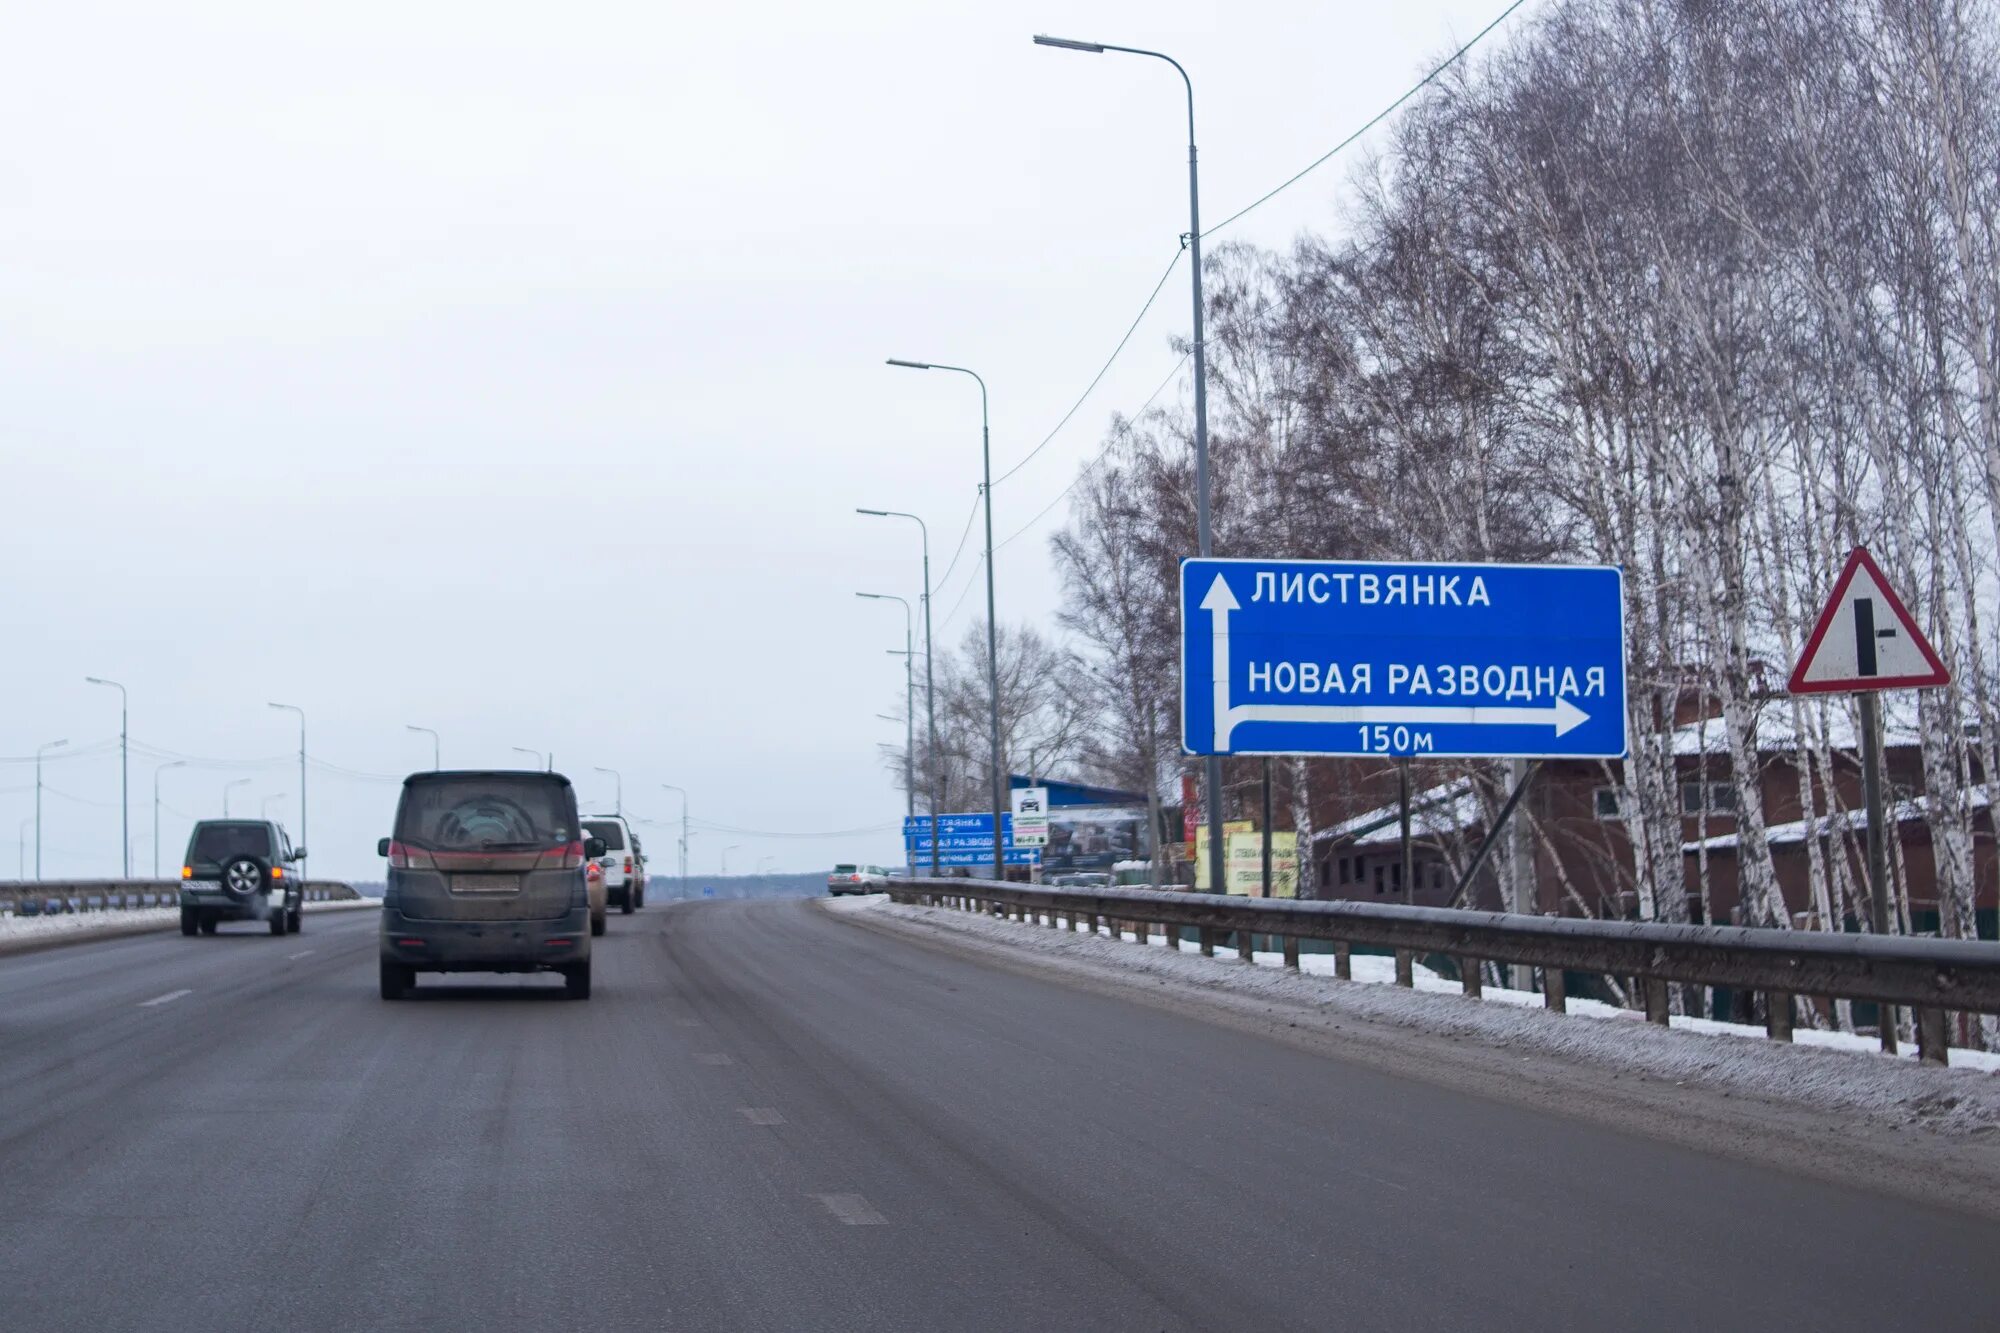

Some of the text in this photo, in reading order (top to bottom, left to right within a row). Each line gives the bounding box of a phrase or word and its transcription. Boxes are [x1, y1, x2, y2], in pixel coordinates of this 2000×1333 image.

[1251, 572, 1491, 606] ЛИСТВЯНКА
[1249, 661, 1605, 701] НОВАЯ РАЗВОДНАЯ
[1358, 725, 1434, 751] 150м
[920, 837, 1009, 847] НОАЯ РАЗВОДНЯ
